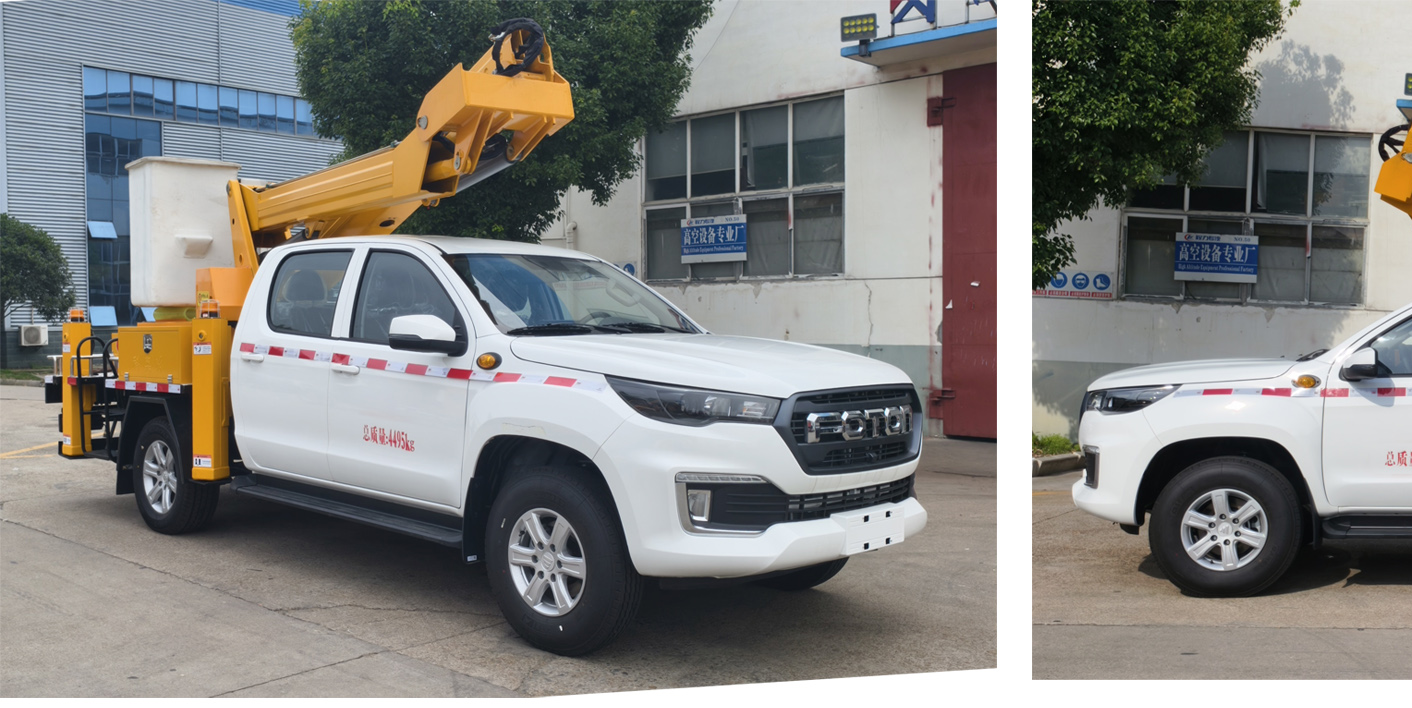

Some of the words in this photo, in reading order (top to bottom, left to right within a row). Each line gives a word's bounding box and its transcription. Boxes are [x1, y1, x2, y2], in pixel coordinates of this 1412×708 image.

[683, 225, 744, 246] 高空设备专业厂
[1179, 242, 1256, 263] 高空设备专业厂
[363, 424, 415, 452] 总质量:4495kg
